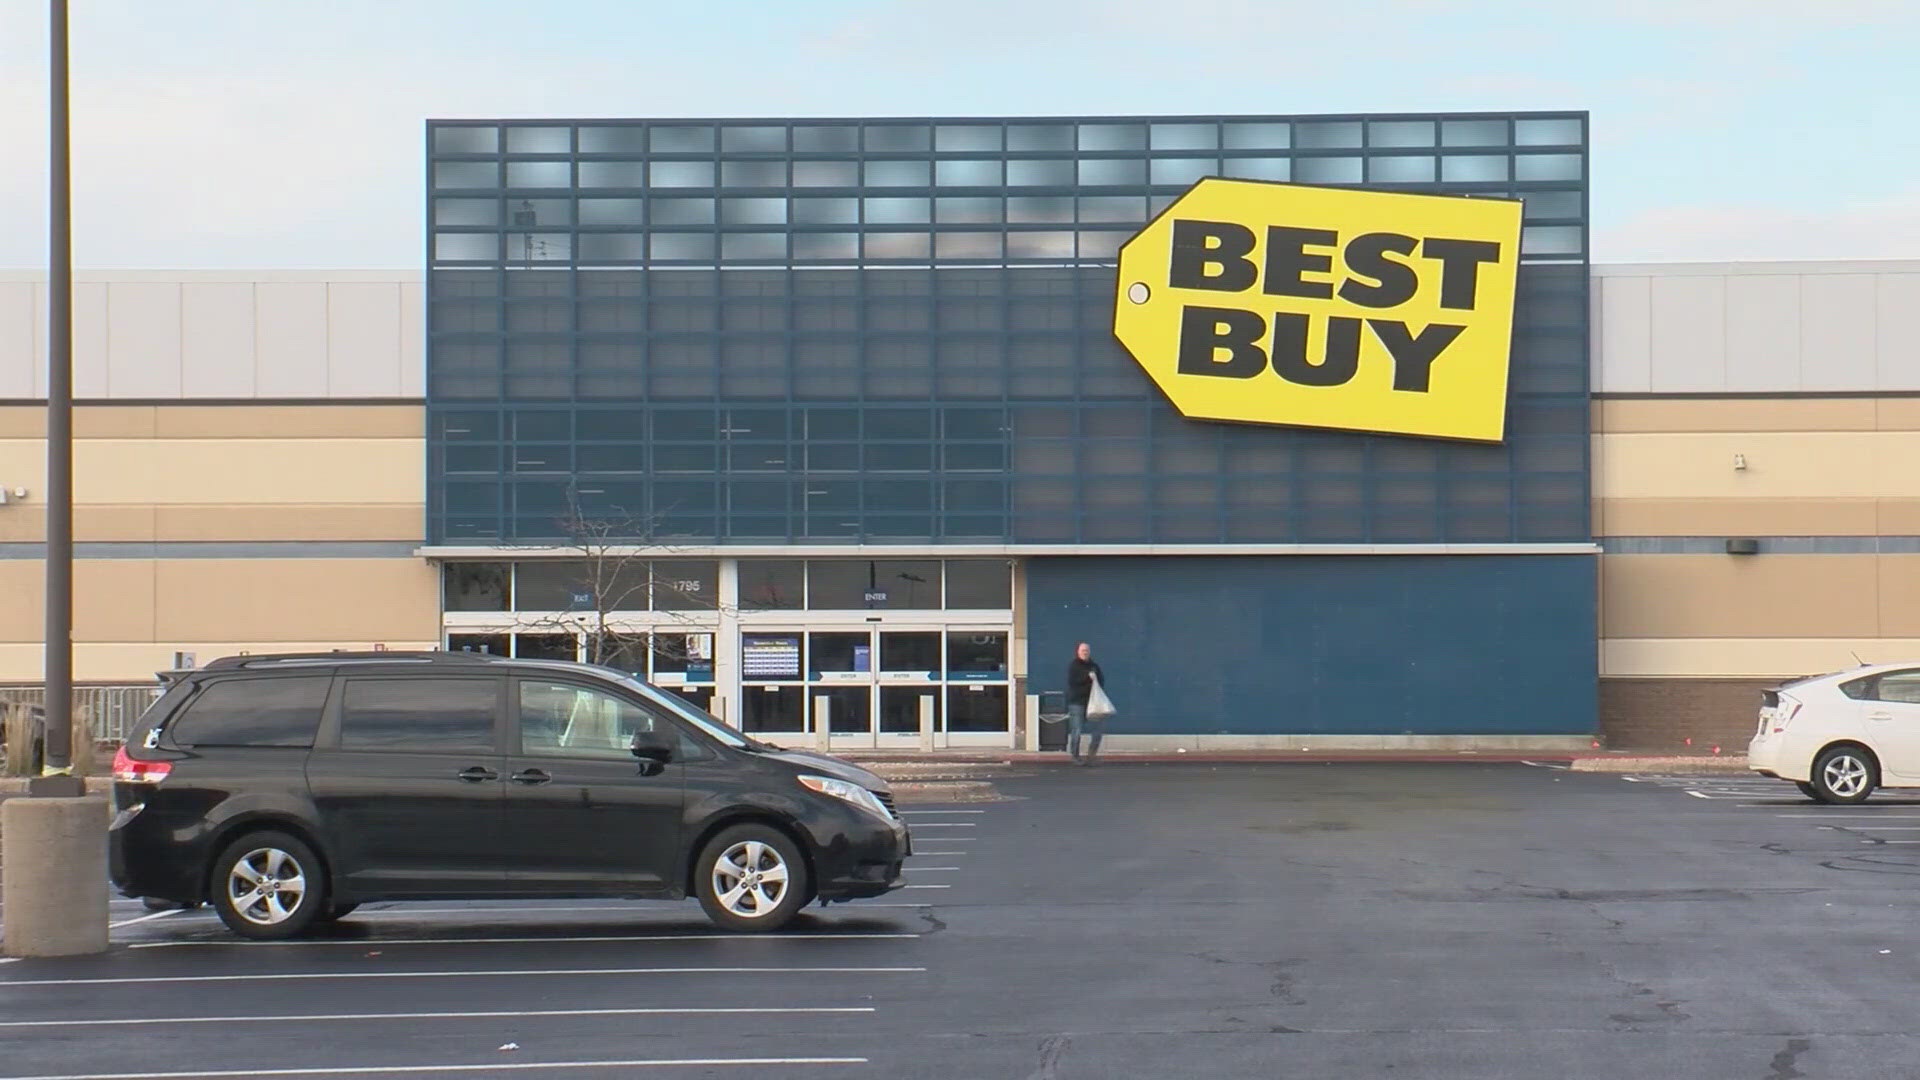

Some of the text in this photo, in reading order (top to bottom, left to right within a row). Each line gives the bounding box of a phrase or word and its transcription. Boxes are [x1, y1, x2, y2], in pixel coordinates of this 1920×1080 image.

[1169, 218, 1501, 311] BEST
[1177, 304, 1469, 393] BUY
[865, 593, 887, 601] ENTER
